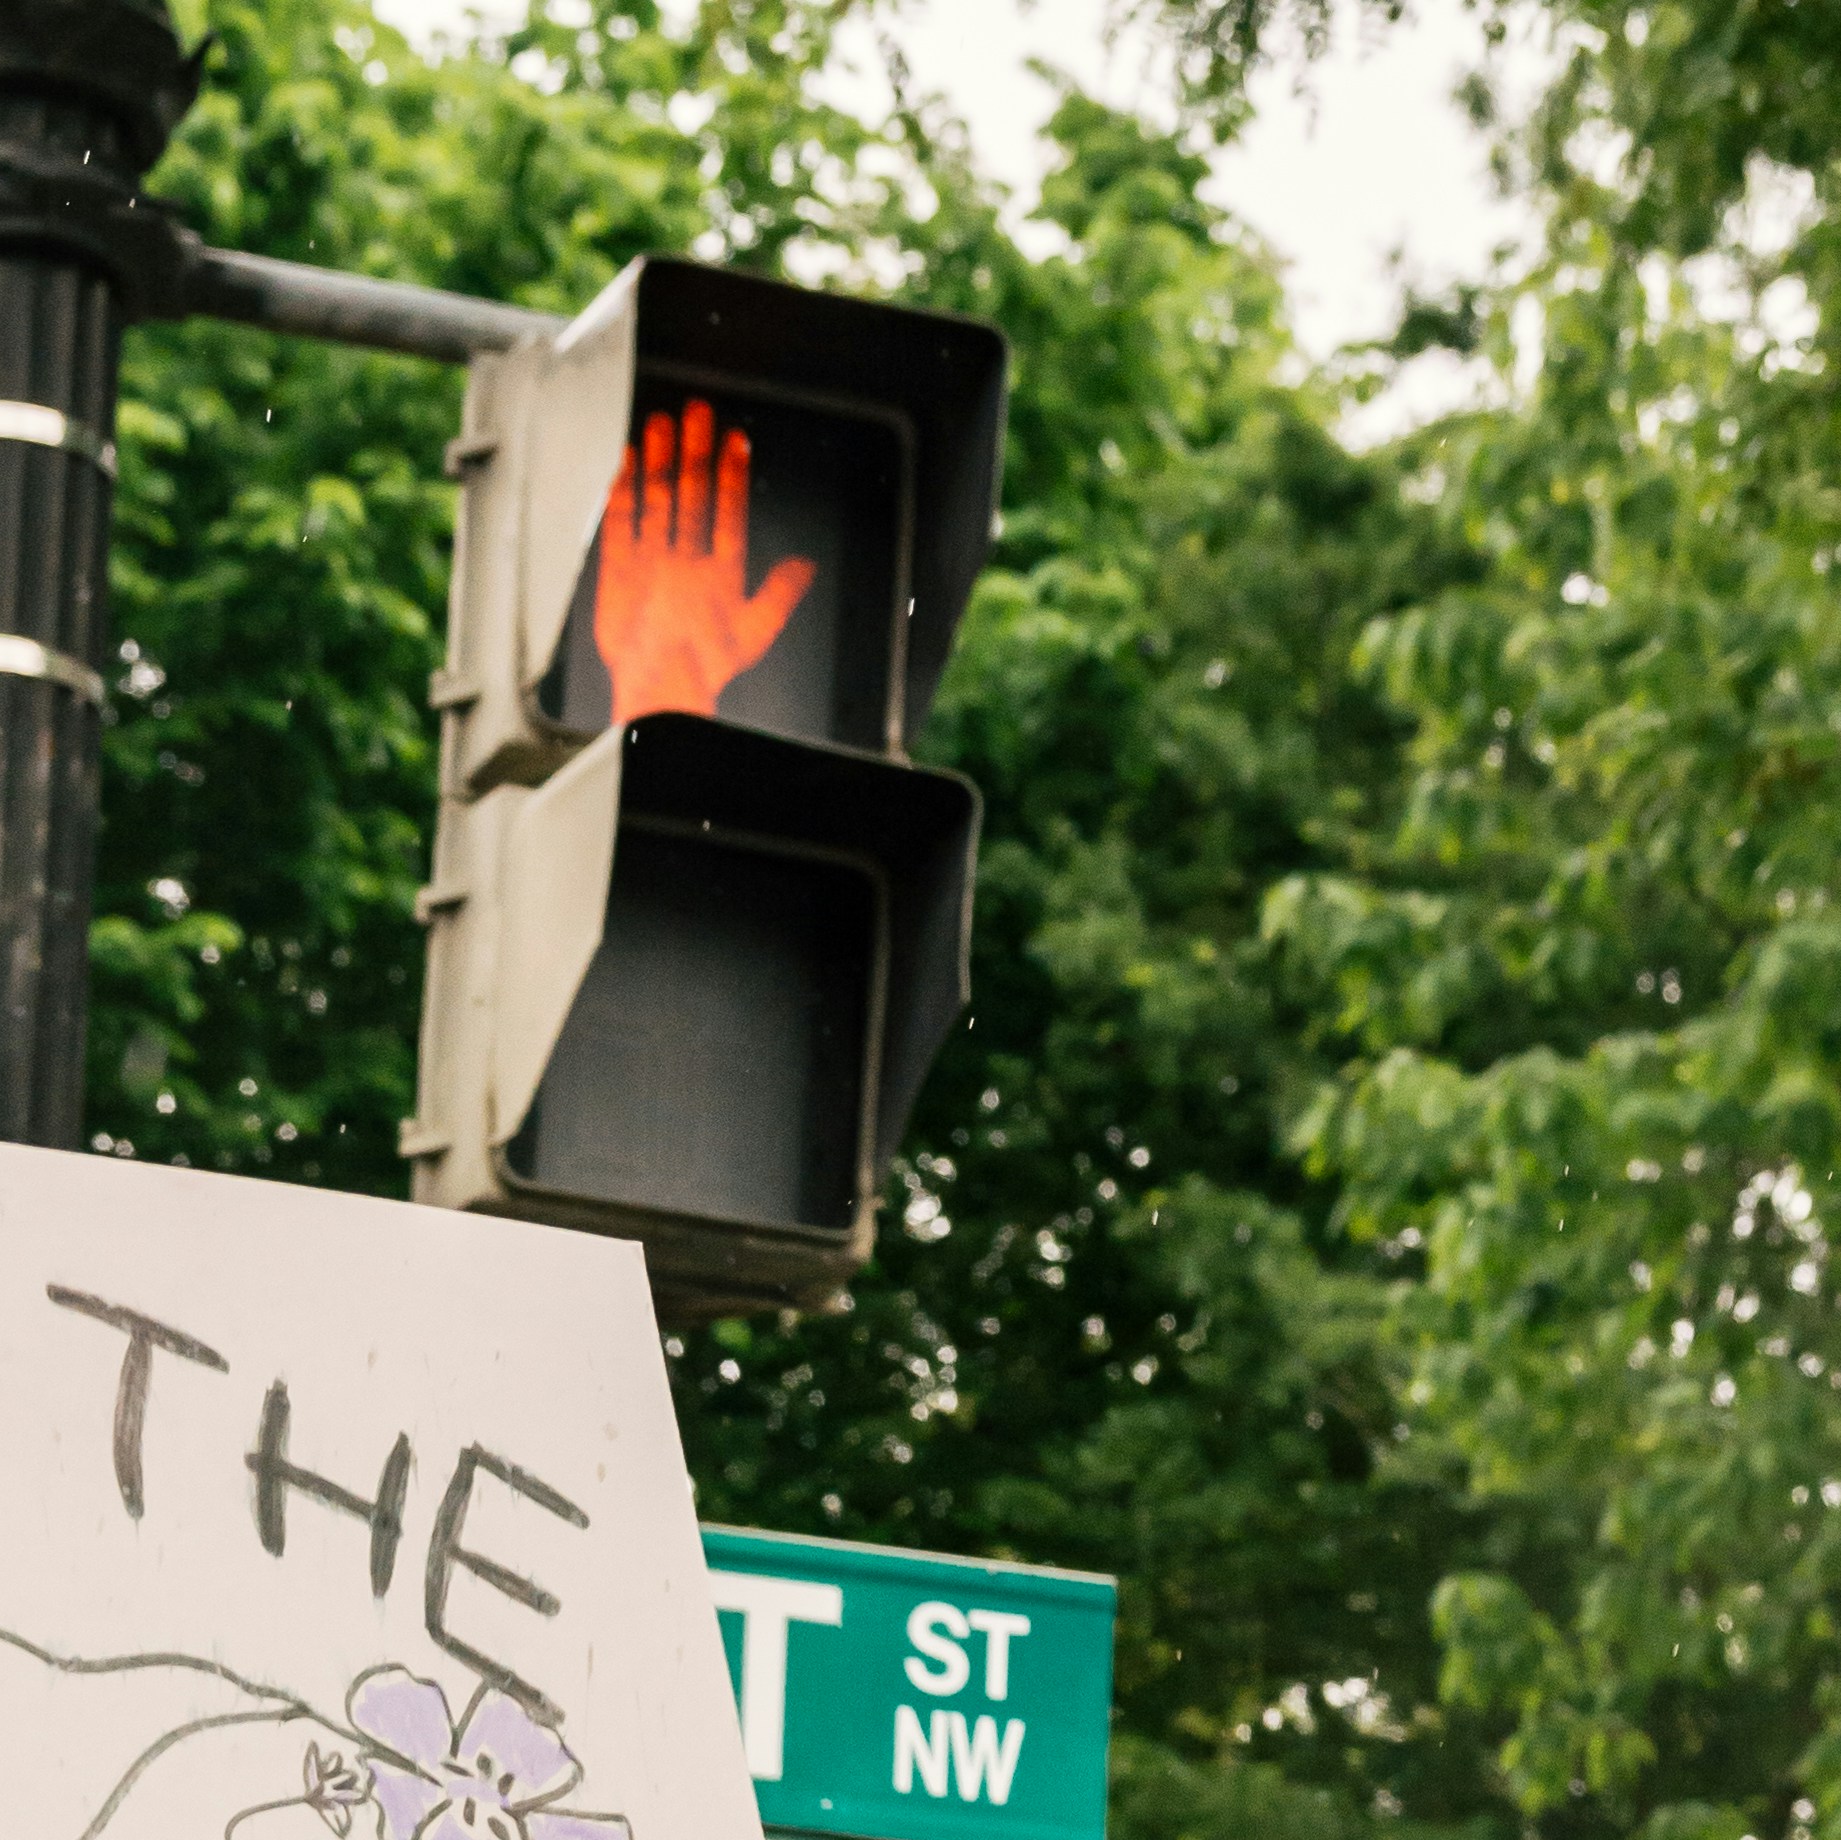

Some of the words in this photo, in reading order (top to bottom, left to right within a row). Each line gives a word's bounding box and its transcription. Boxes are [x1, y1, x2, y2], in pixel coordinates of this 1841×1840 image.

[46, 1281, 590, 1726] THE
[903, 1600, 1031, 1701] ST
[892, 1704, 1026, 1805] NW
